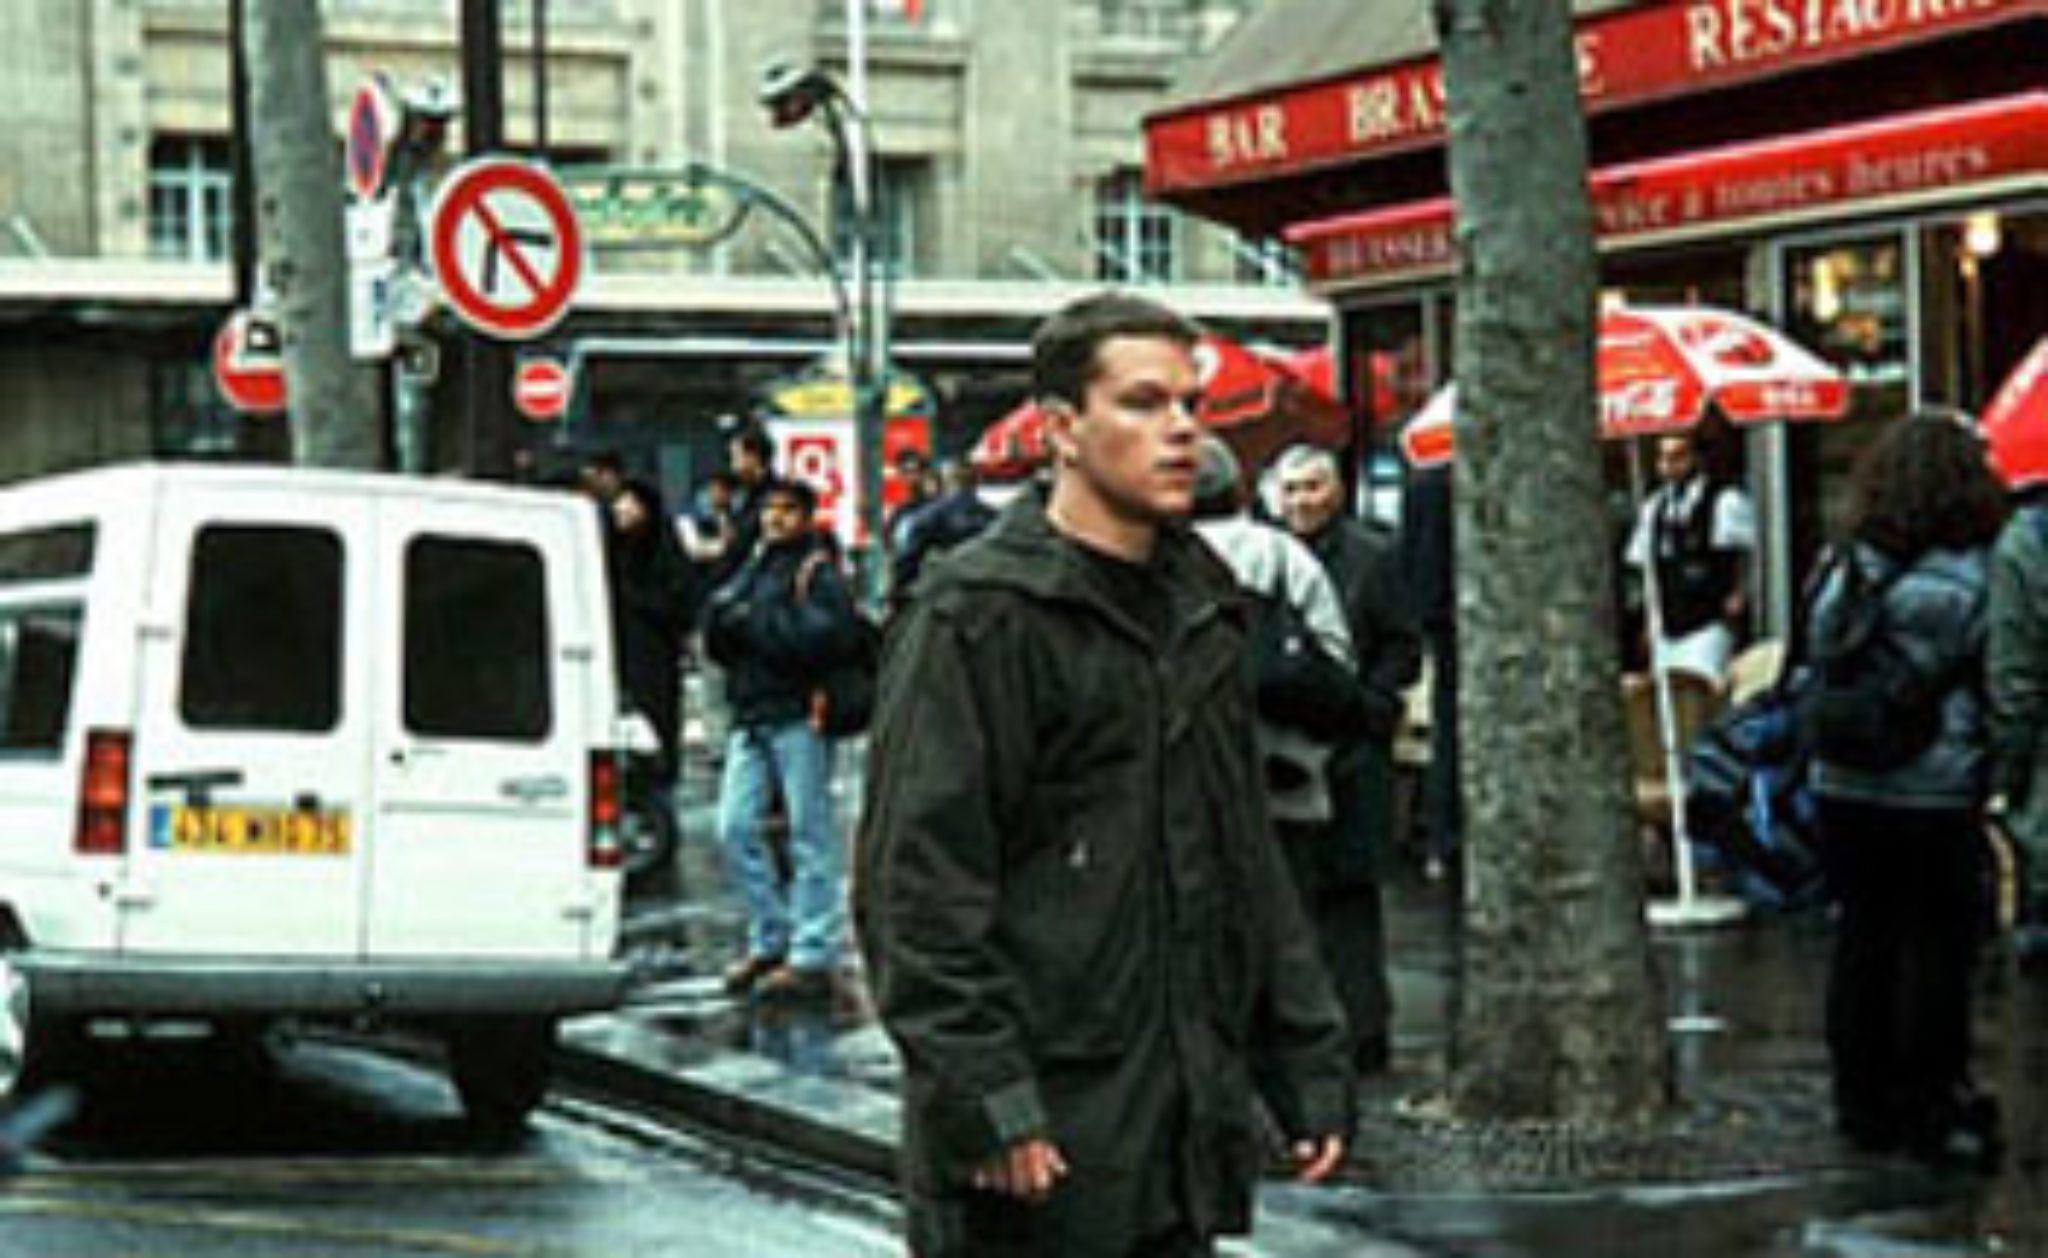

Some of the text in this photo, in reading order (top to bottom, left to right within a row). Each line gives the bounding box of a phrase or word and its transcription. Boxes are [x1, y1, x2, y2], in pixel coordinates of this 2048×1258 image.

[1206, 102, 1288, 165] BAR
[1685, 0, 1995, 71] RESTAU
[1843, 140, 1990, 199] heures
